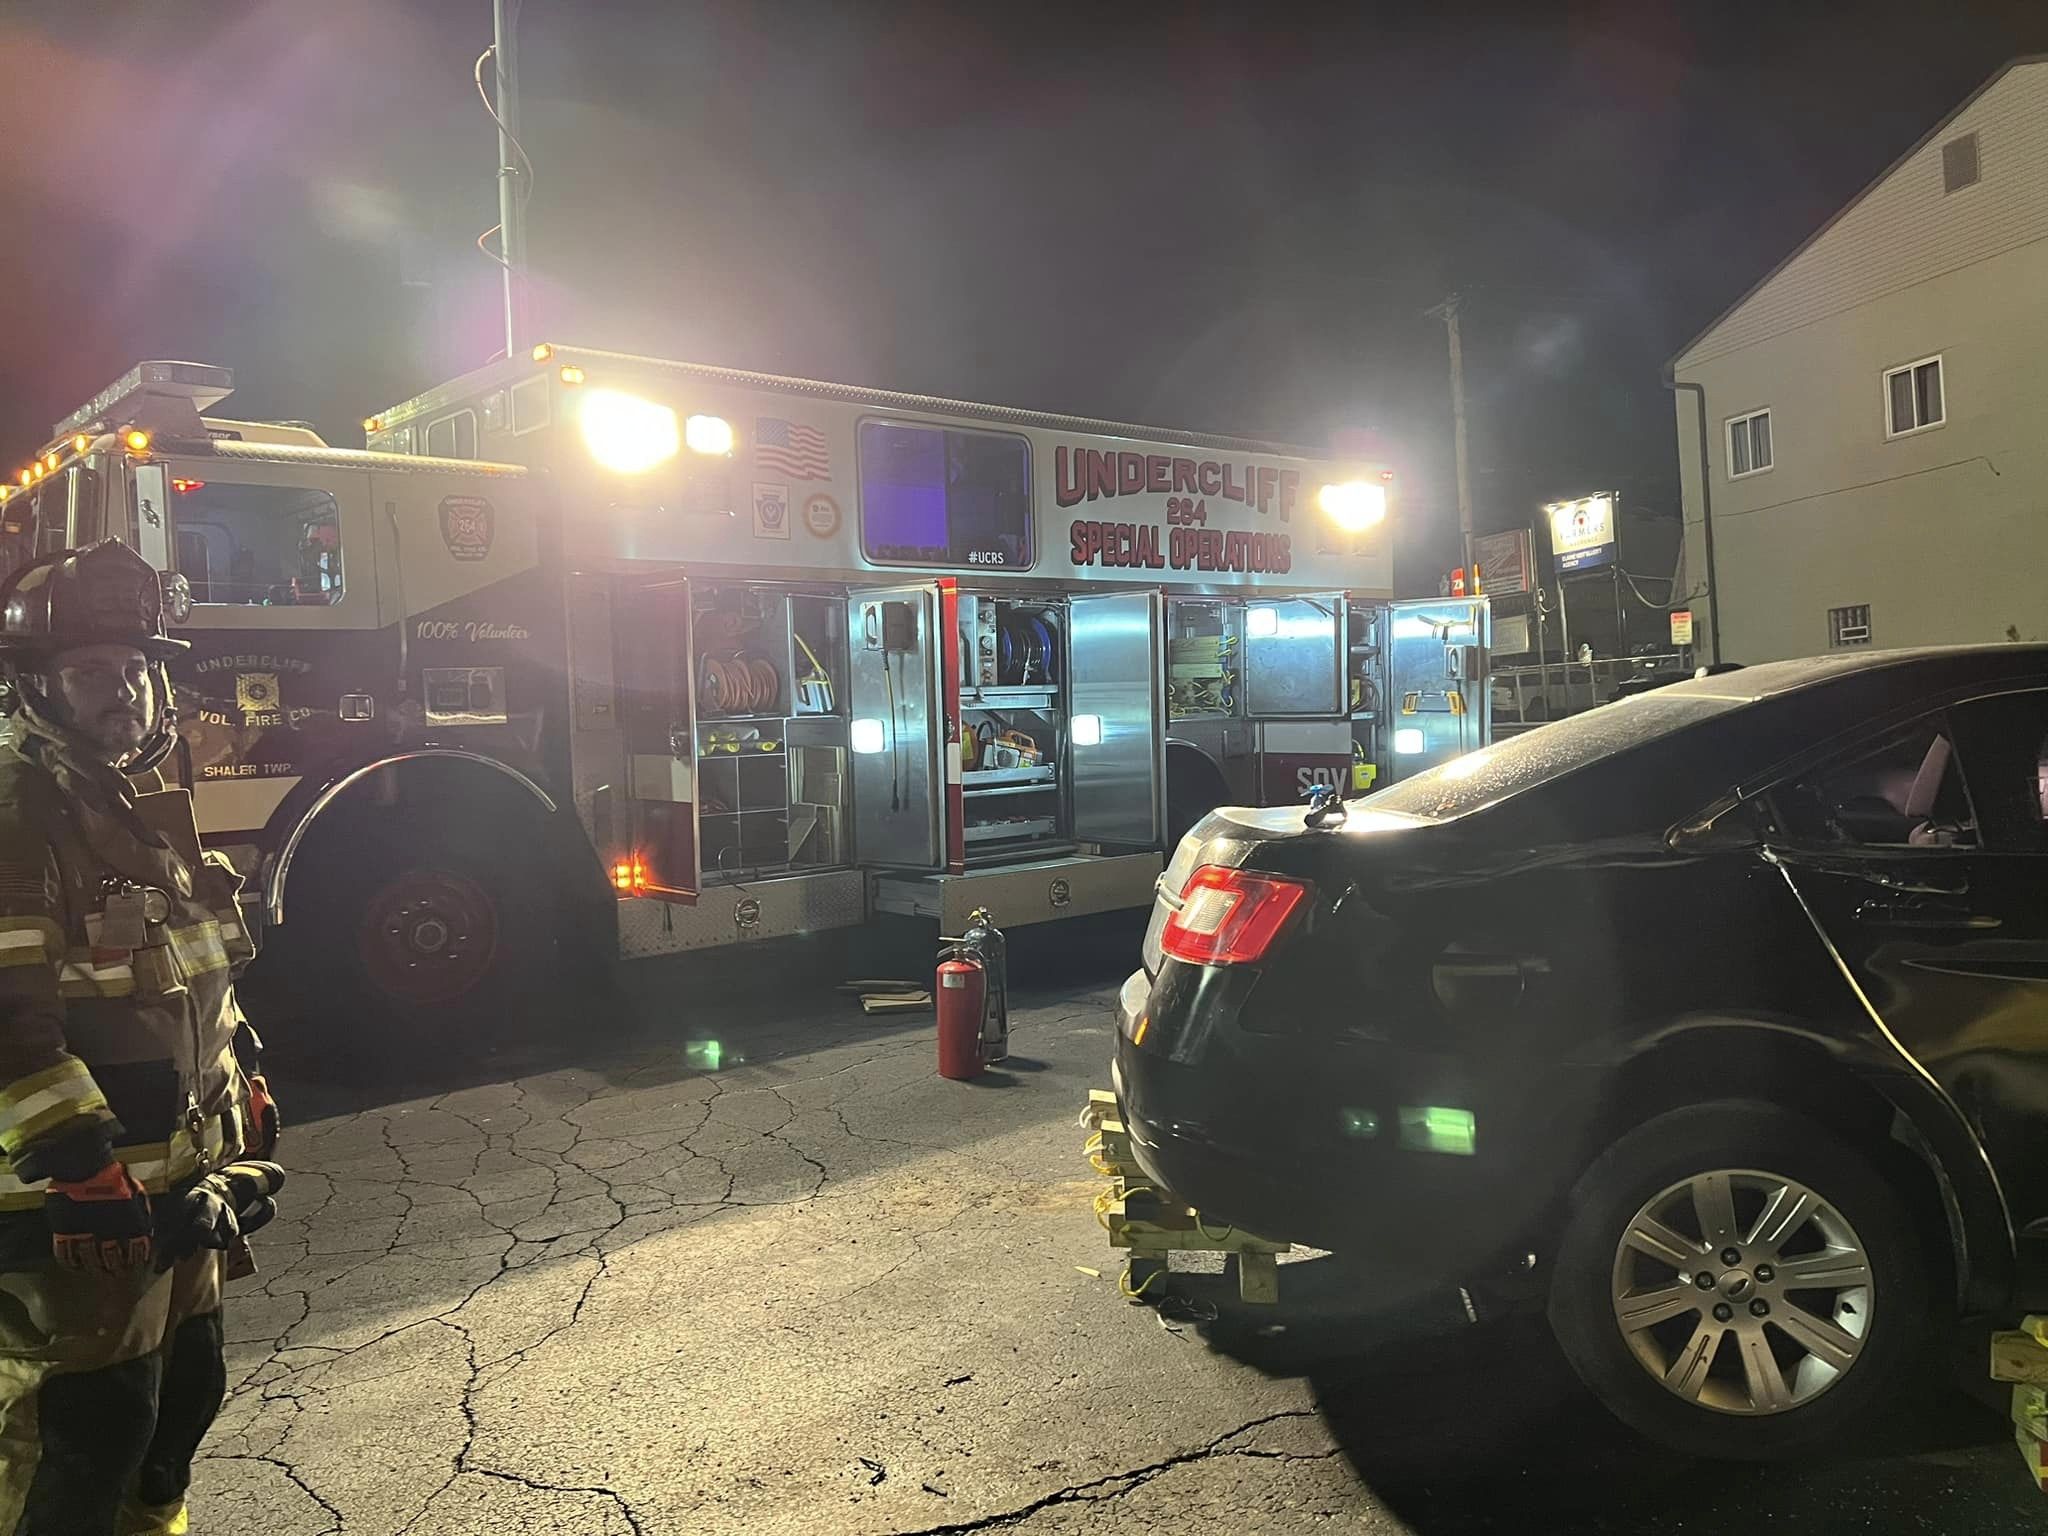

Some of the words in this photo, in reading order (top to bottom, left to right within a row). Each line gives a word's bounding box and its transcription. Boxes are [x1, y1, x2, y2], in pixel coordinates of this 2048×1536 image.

[1055, 446, 1300, 522] UNDERCLIFF
[968, 551, 1004, 564] #UCRS
[1070, 520, 1165, 569] SPECIAL
[1169, 527, 1291, 574] OPERATIONS
[417, 621, 458, 639] 100%
[464, 622, 529, 642] Volunteer
[200, 710, 236, 727] VOL.
[245, 713, 282, 727] FIRE
[204, 764, 257, 777] SHALER
[1297, 767, 1348, 796] SOV
